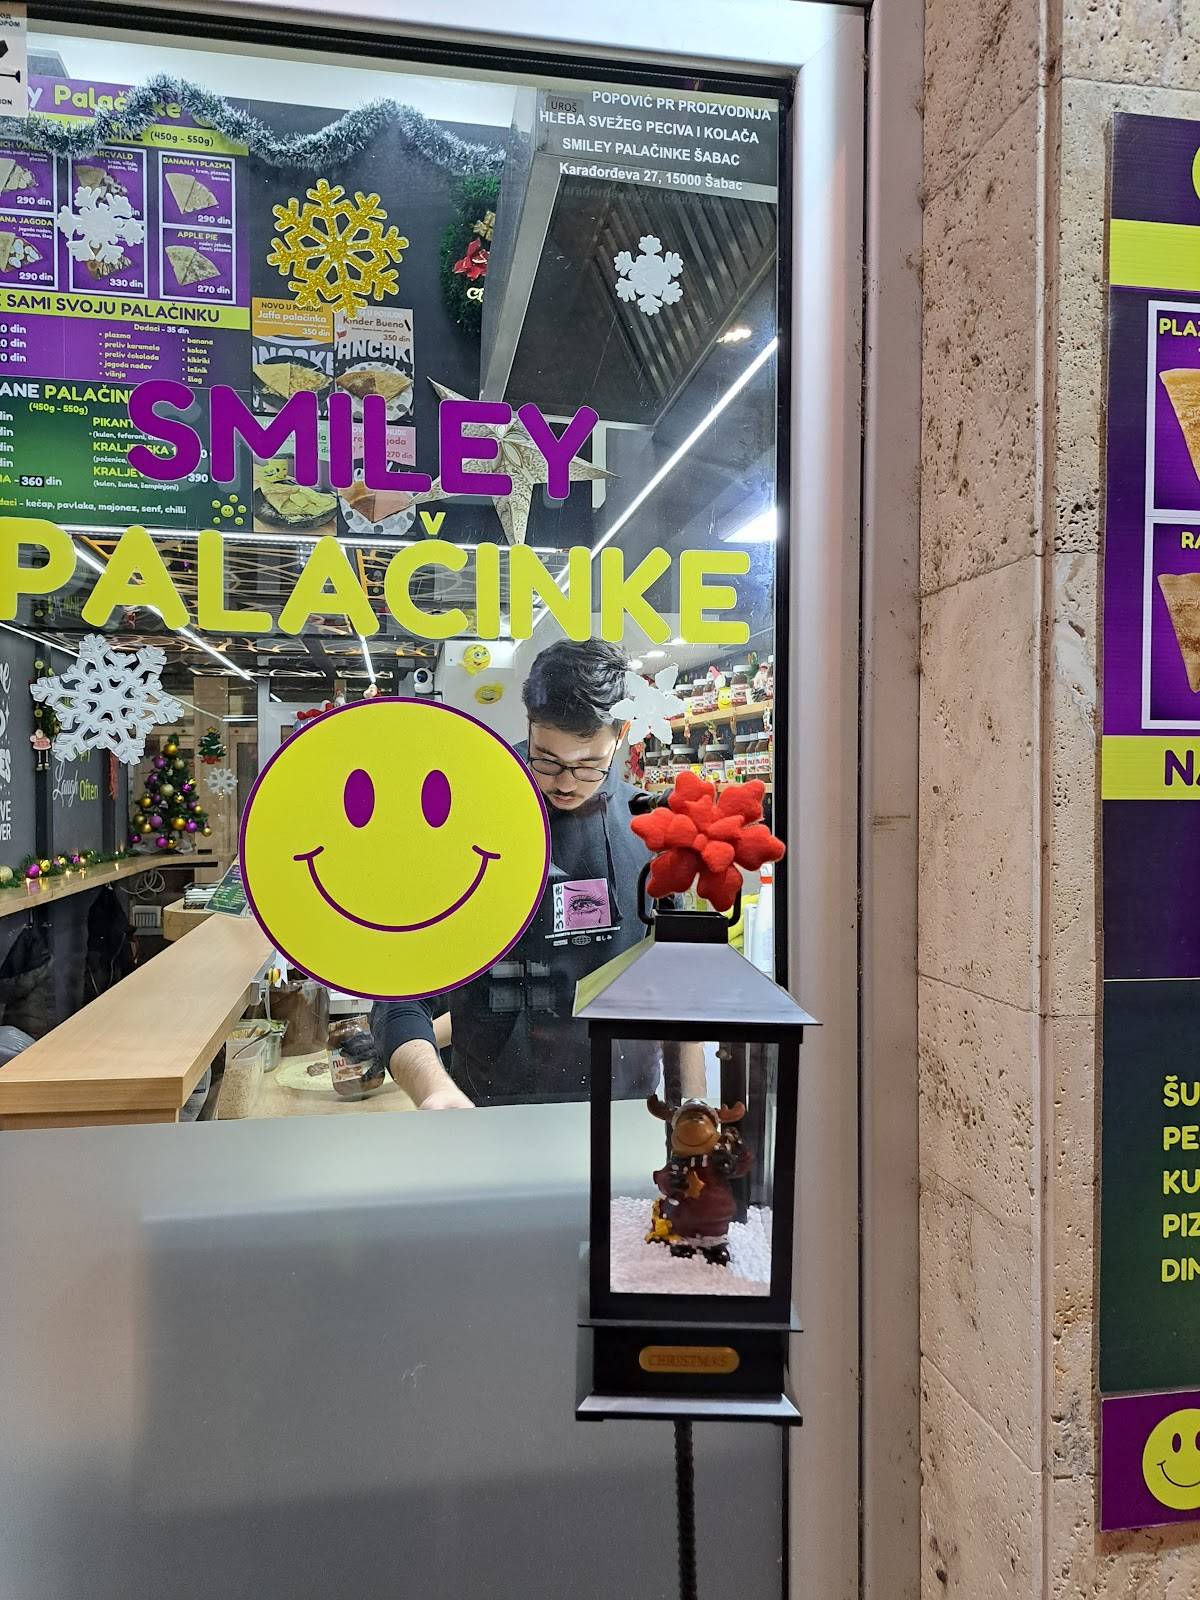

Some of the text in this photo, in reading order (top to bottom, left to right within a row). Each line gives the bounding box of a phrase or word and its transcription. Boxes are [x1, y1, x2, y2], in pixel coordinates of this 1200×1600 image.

[54, 84, 181, 119] Palačke
[551, 101, 577, 113] UROŠ
[592, 91, 771, 121] POPOVIĆ PR PROIZVODNJA
[539, 110, 759, 144] HLEBA SVEŽEG PECIVA I KOLAČA
[150, 131, 178, 143] (450g
[187, 135, 214, 147] 550g)
[562, 137, 740, 166] SMILEY PALAČINKE ŠABAC
[163, 157, 194, 167] BANANA
[200, 161, 231, 169] PLAZMA
[559, 162, 743, 191] Karađorđeva 27, 15000 Šabac
[16, 196, 51, 206] 290 din
[19, 217, 53, 226] JAGODA
[197, 214, 231, 225] 290 din
[177, 231, 218, 241] APPLE PIE
[19, 271, 53, 281] 290 din
[109, 278, 143, 288] 330 din
[197, 285, 231, 295] 270 din
[7, 293, 220, 322] SAMI SVOJU PALAČINKU
[10, 324, 27, 334] din
[133, 323, 160, 333] Dodaci
[166, 326, 177, 334] 35
[177, 327, 190, 336] din
[376, 318, 404, 329] Bueno
[1159, 317, 1200, 337] PLA
[10, 338, 27, 348] din
[10, 352, 27, 362] din
[44, 384, 132, 404] PALAČIN
[29, 401, 56, 413] (450g
[62, 404, 89, 416] 550g)
[92, 416, 134, 429] PIKANT
[127, 378, 600, 500] SMILEY
[21, 476, 43, 486] 360
[45, 476, 62, 486] din
[25, 498, 55, 509] kečap,
[57, 501, 96, 512] pavlaka,
[98, 502, 140, 513] majonez,
[141, 504, 163, 514] senf,
[164, 505, 187, 514] chilli
[0, 511, 751, 645] PALAČINKE
[1164, 749, 1200, 787] N
[79, 778, 99, 801] Often
[1163, 1074, 1200, 1107] ŠU
[1163, 1125, 1200, 1151] PE
[1163, 1168, 1200, 1195] KU
[649, 1353, 728, 1368] CHRISTMAS
